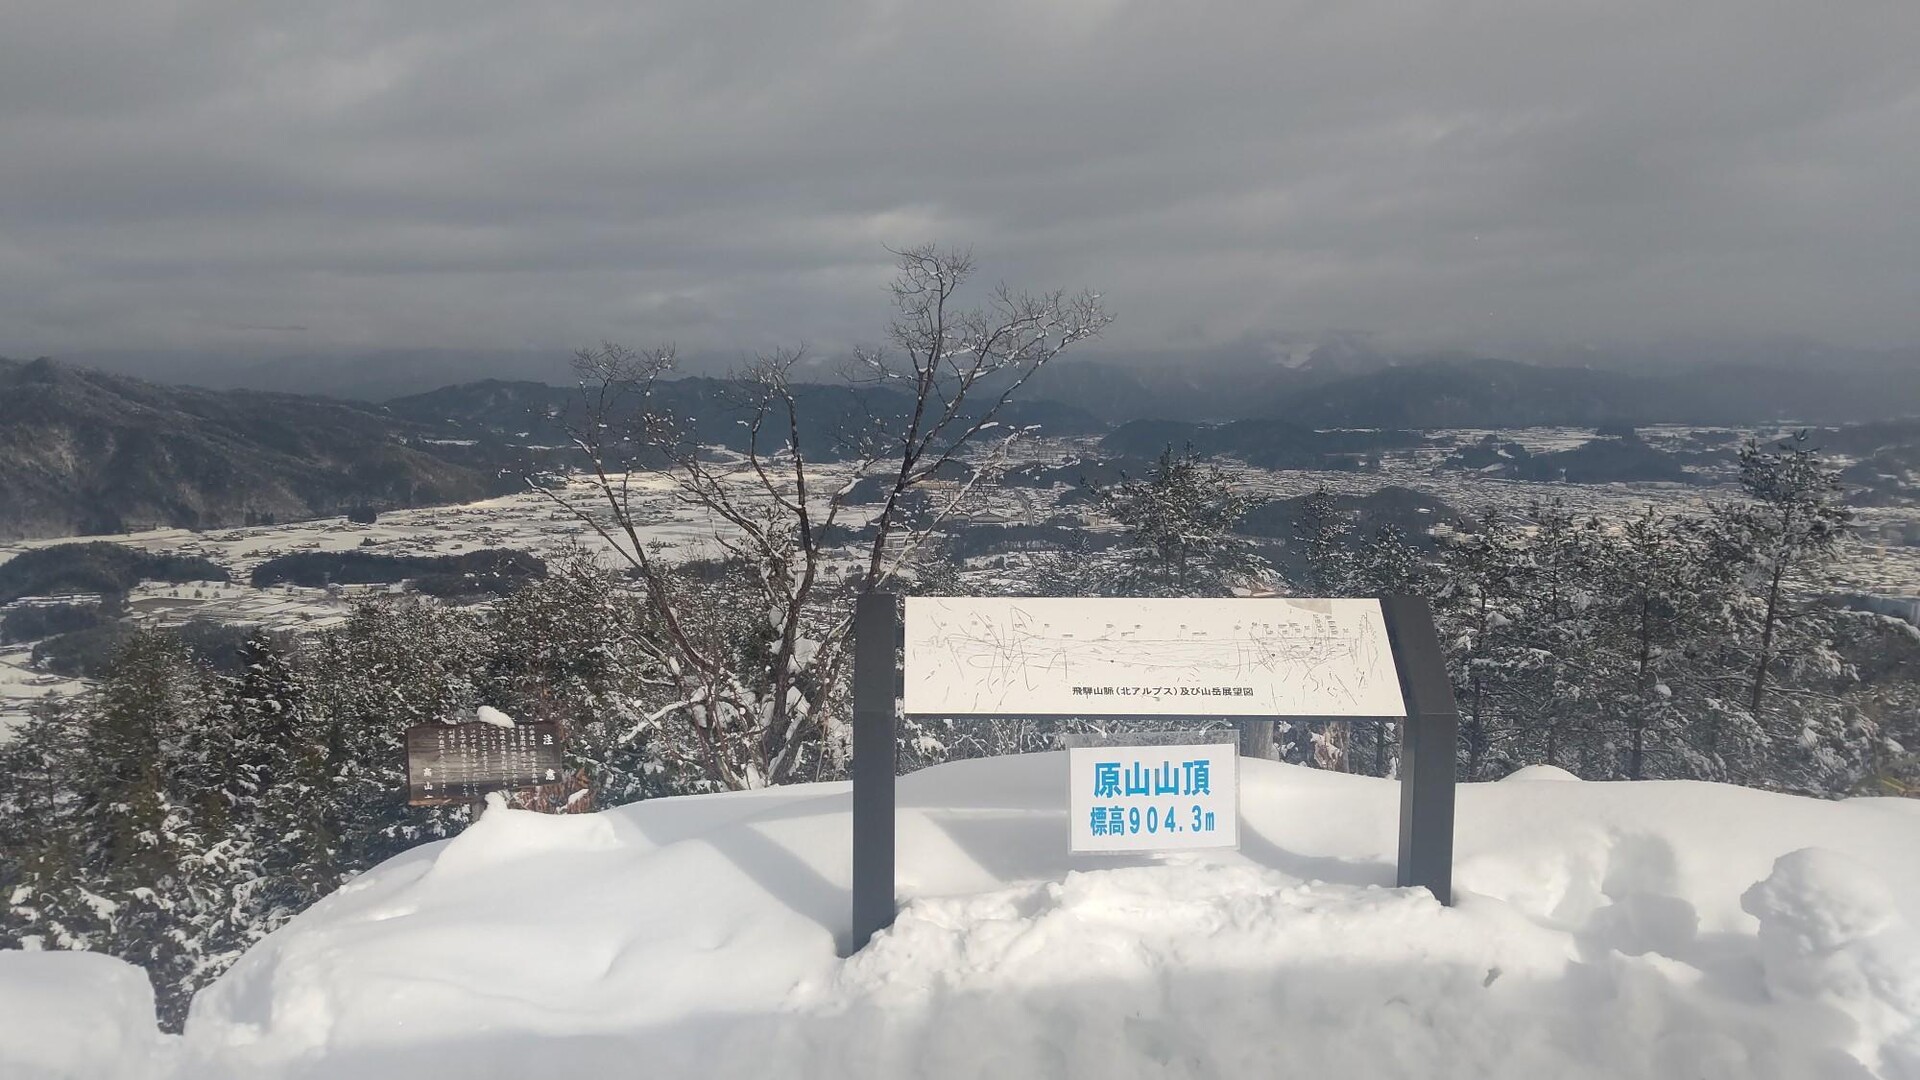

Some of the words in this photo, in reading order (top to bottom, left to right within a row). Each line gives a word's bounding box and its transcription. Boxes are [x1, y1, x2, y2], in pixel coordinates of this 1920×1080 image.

[1093, 759, 1211, 799] 原山山頂
[1090, 805, 1215, 836] 標高904.3m
